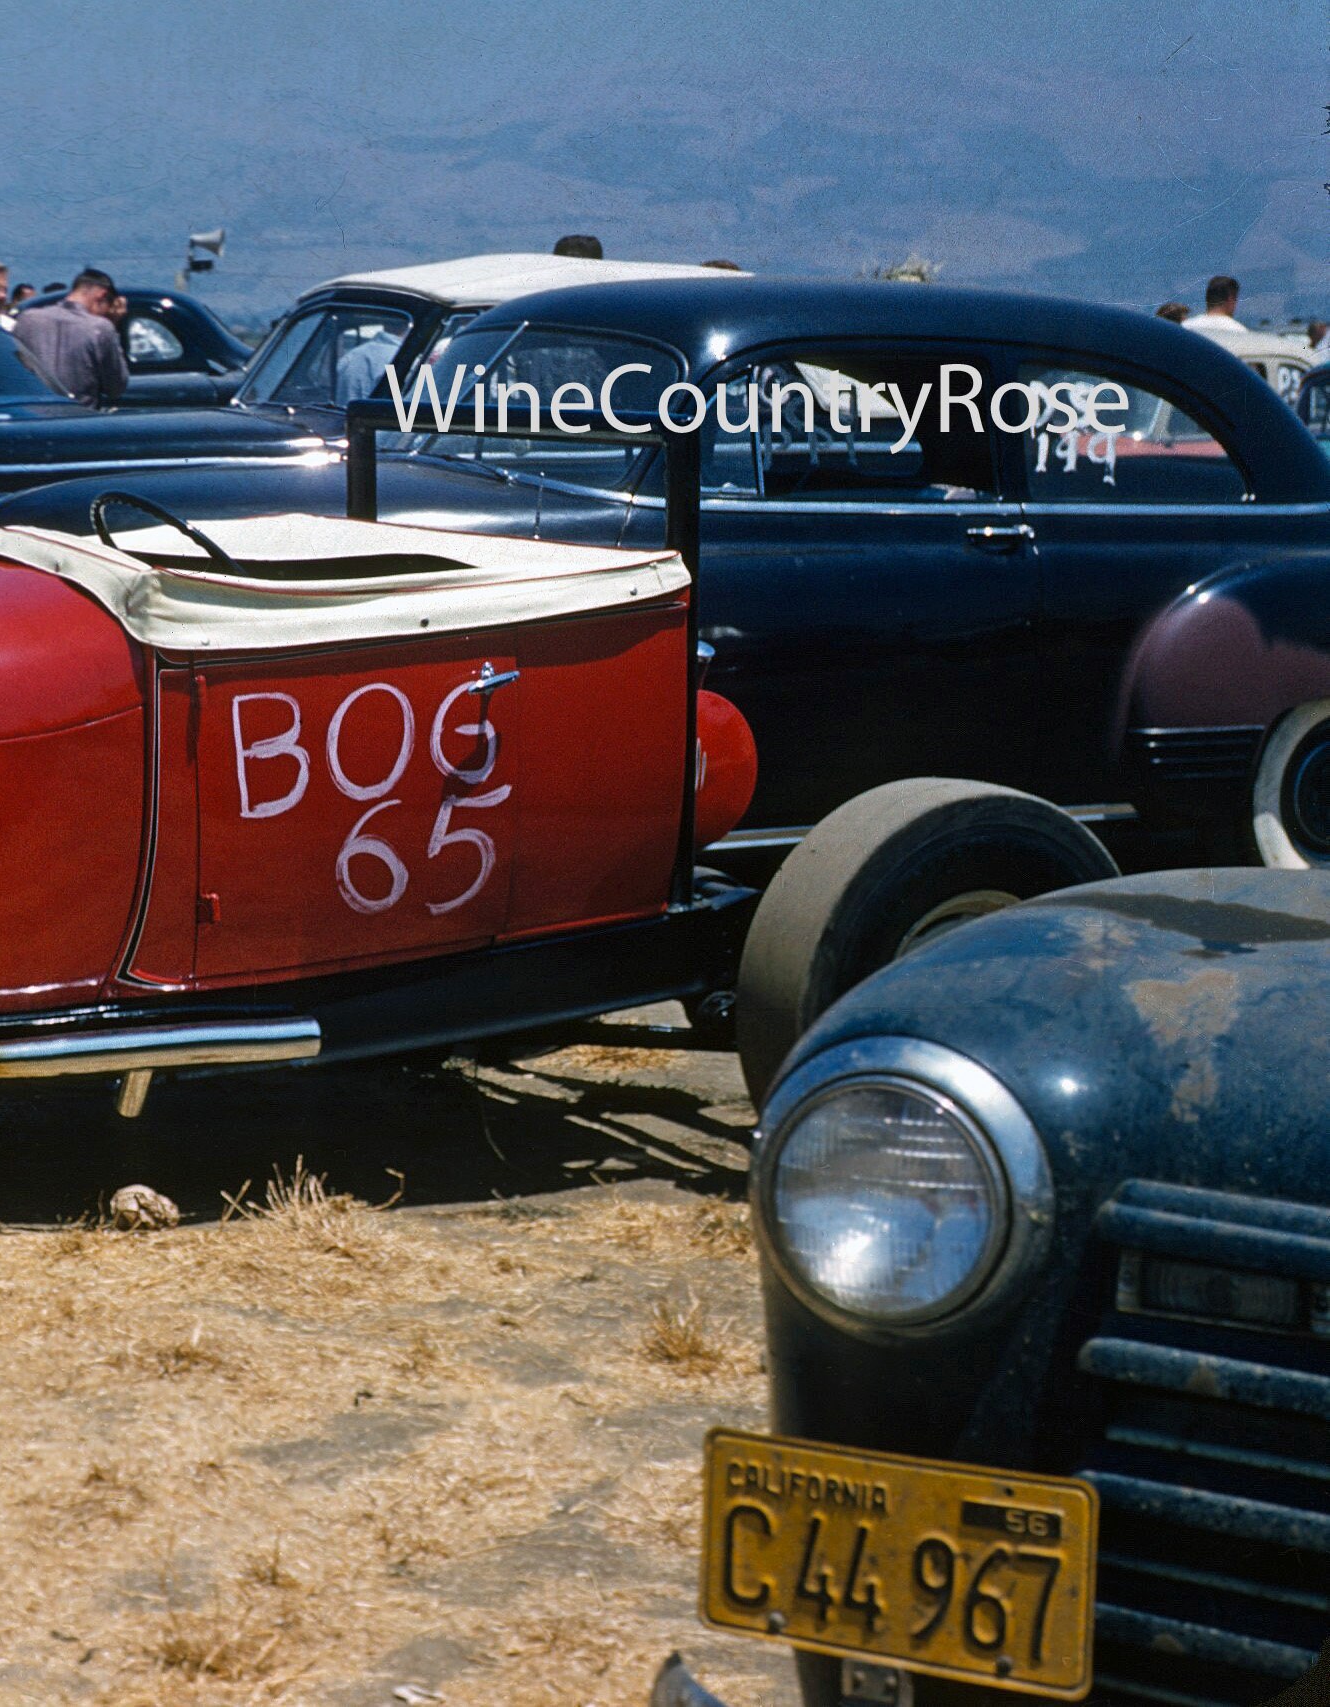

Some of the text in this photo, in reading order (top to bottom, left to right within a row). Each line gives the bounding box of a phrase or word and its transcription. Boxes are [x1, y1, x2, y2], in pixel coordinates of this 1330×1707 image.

[233, 682, 497, 819] BOG
[335, 785, 512, 915] 65
[727, 1460, 889, 1515] CALIFORNIA
[1005, 1508, 1049, 1538] 56
